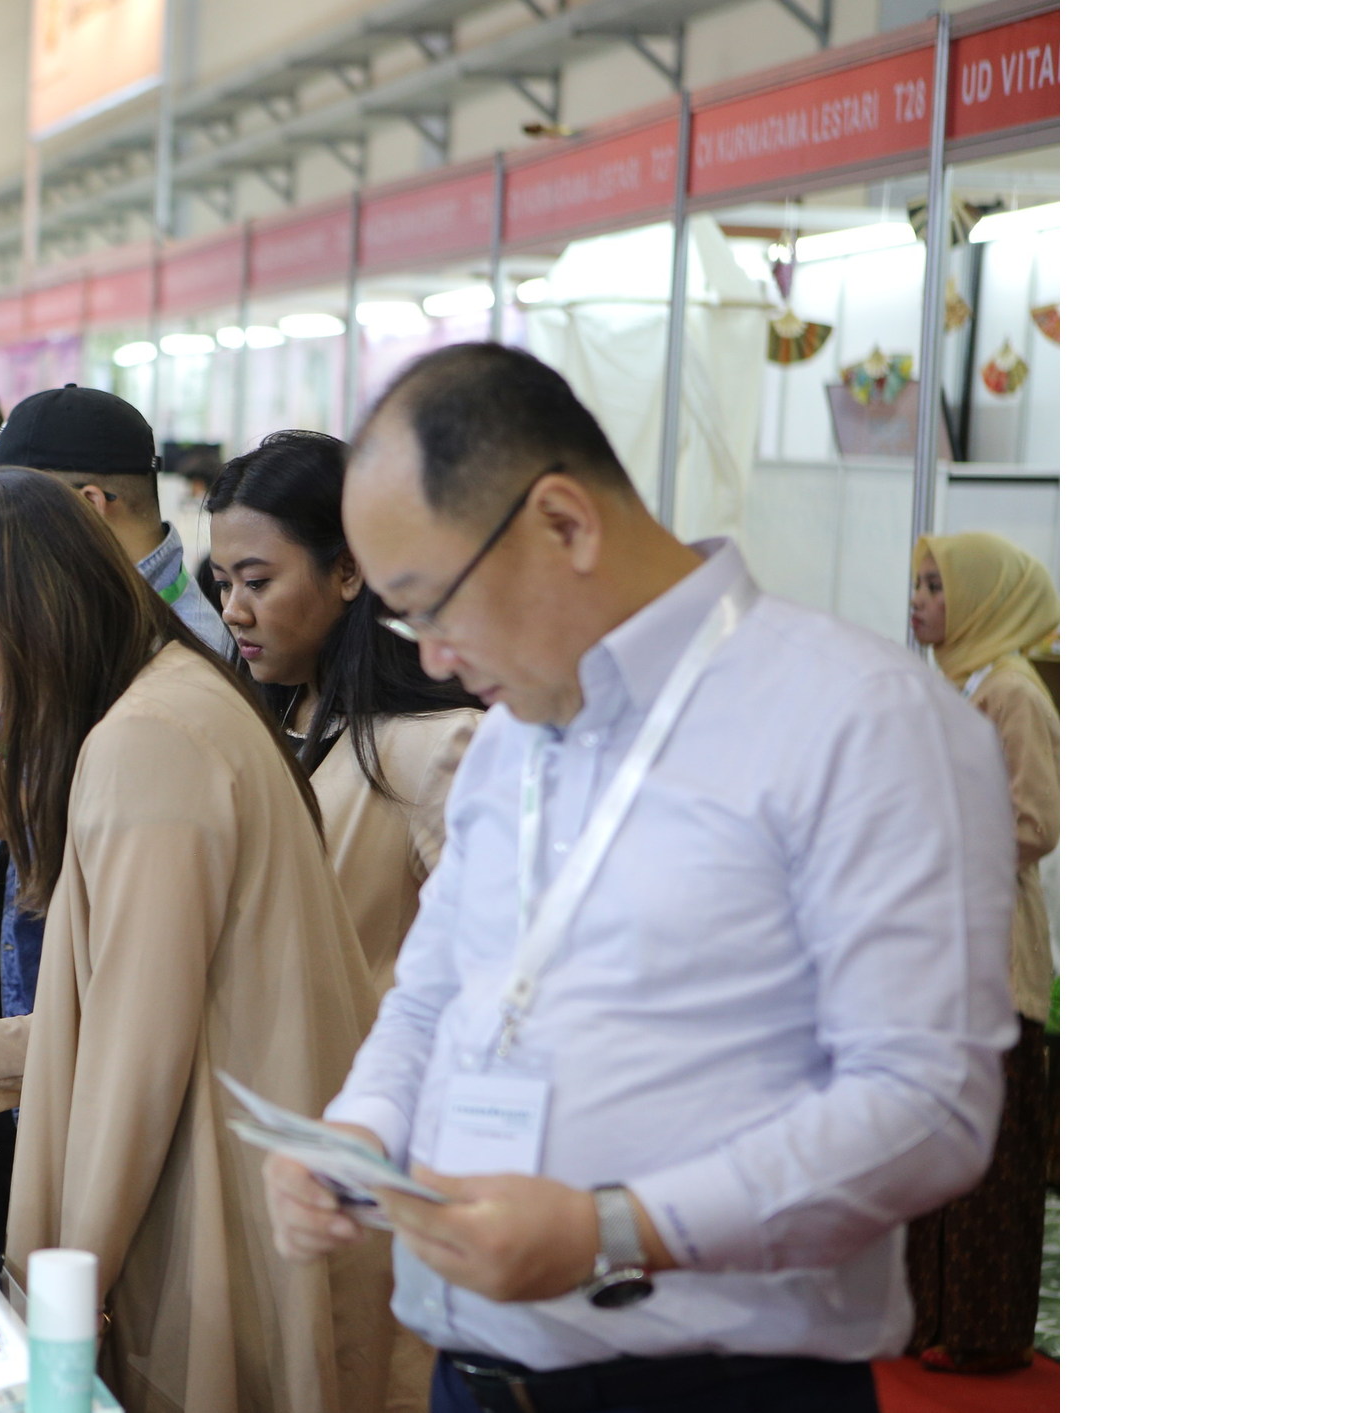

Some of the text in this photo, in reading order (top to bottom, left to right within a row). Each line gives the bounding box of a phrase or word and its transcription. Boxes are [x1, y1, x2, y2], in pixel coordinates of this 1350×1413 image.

[962, 43, 1060, 106] UD VITA
[812, 88, 880, 145] LESTARI
[894, 78, 927, 124] T28
